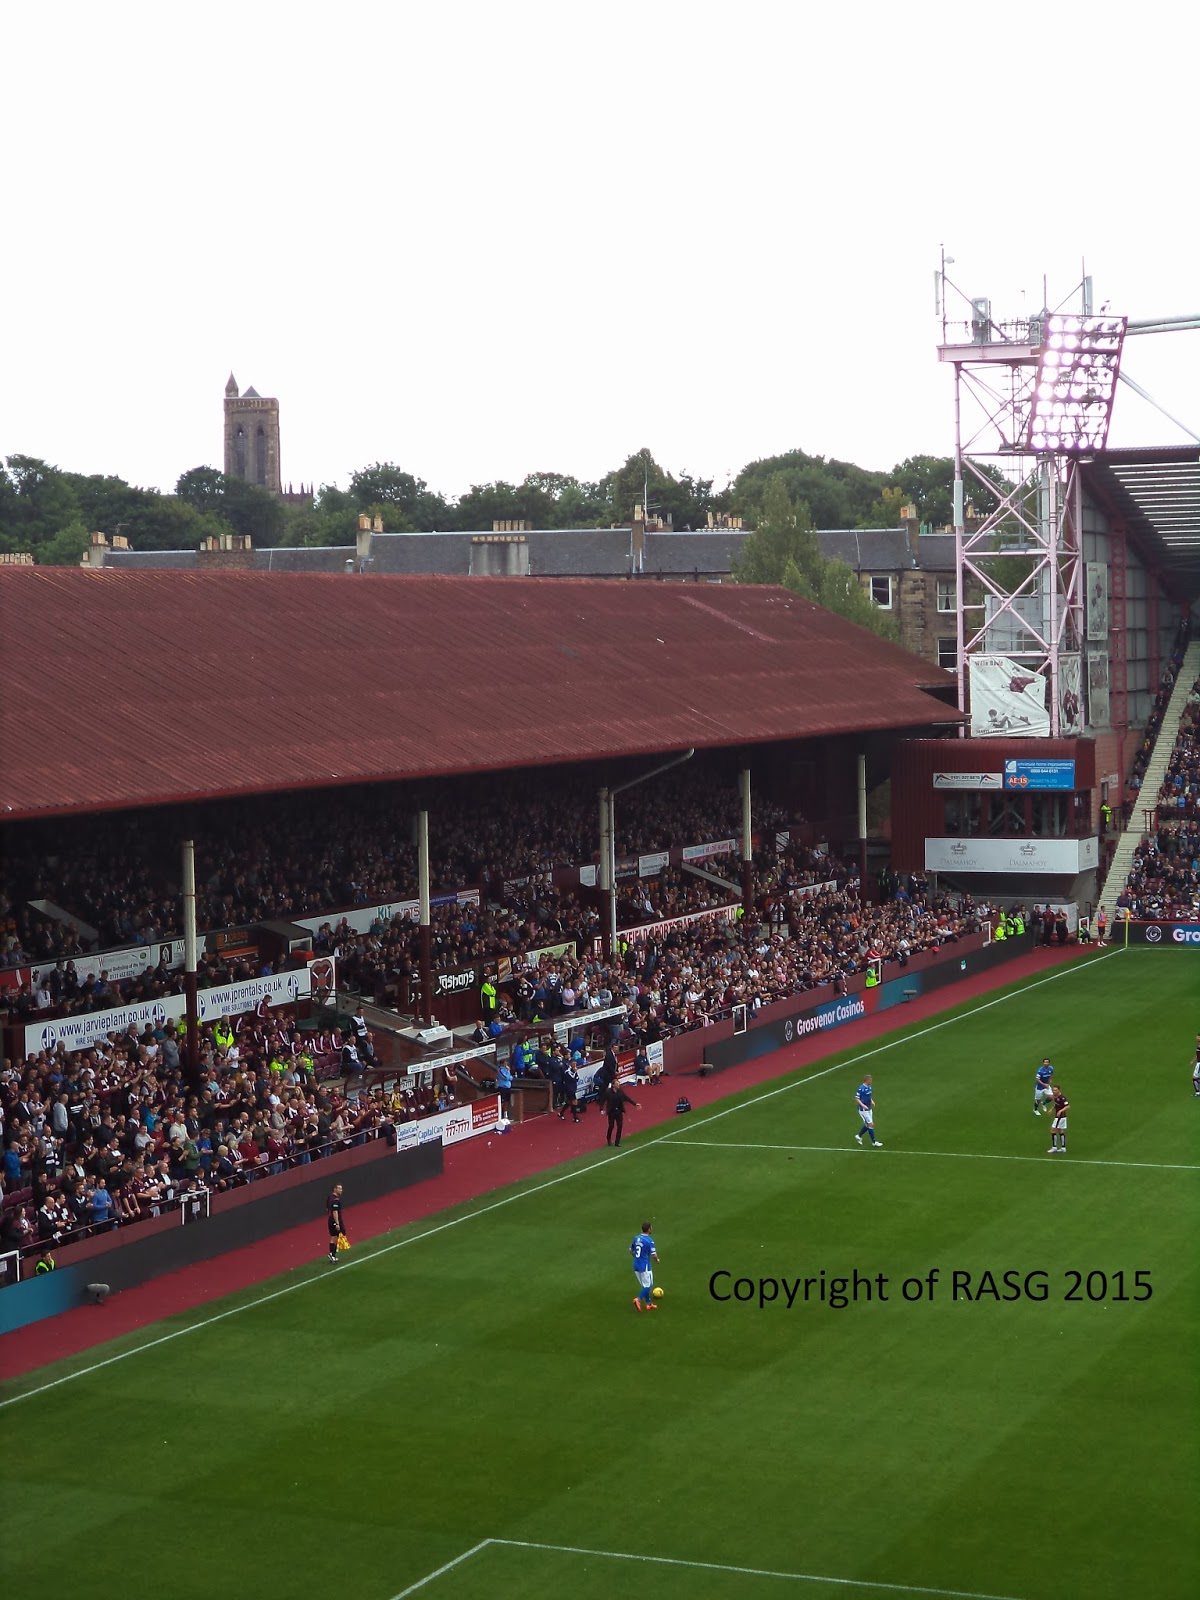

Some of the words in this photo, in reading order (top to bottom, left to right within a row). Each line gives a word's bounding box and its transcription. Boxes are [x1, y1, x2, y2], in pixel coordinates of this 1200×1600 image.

[1009, 859, 1047, 867] DALMAHOY
[376, 905, 392, 919] KIT
[1172, 928, 1200, 942] Gro
[210, 978, 283, 1005] www.jprentals.co.uk
[221, 1005, 231, 1013] HIRE
[231, 1000, 253, 1012] SOLUTIONS
[58, 1006, 150, 1038] www.jarvieplant.co.uk
[796, 1010, 836, 1036] Grosvenor
[836, 1000, 865, 1021] Casinos
[75, 1036, 86, 1045] HIRE
[398, 1127, 410, 1137] Capital
[418, 1123, 435, 1139] Capital
[433, 1125, 444, 1134] Cars
[446, 1121, 470, 1137] 777-7777
[635, 1246, 642, 1258] 3
